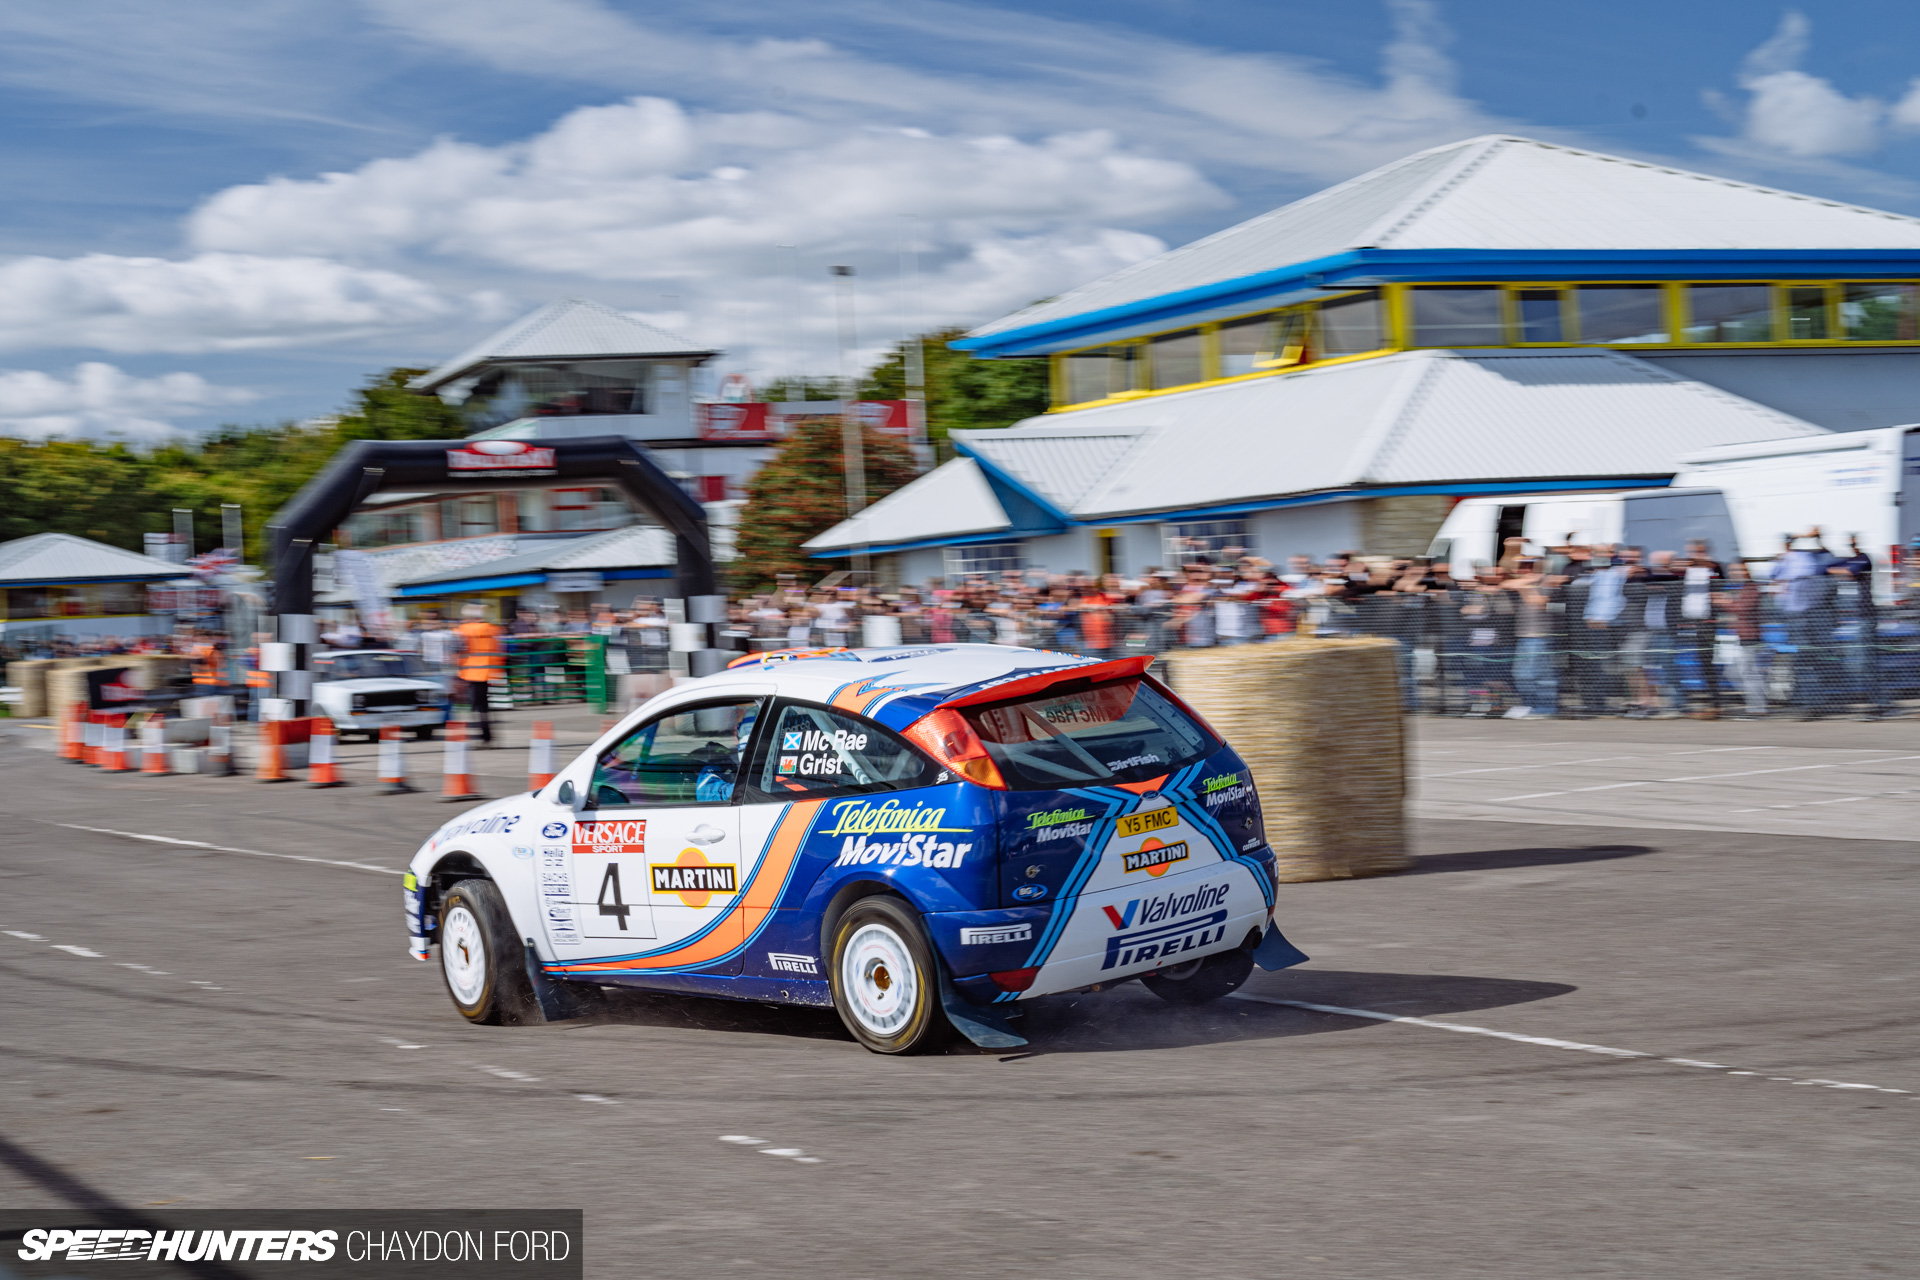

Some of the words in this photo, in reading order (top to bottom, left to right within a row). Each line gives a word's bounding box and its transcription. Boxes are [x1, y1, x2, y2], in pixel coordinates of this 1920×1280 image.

[802, 730, 829, 751] Mc
[832, 729, 867, 751] Rae
[800, 753, 843, 775] Grist
[1106, 754, 1160, 772] DirtFish
[1206, 785, 1246, 808] MoviStar
[574, 821, 645, 845] VERSACE
[1036, 822, 1093, 843] MoviStar
[1124, 818, 1141, 833] Y5
[1144, 811, 1172, 830] FMC
[592, 845, 624, 853] SPORT
[834, 833, 973, 869] MoviStar
[1127, 842, 1187, 870] MARTINI
[654, 868, 733, 890] MARTINI
[598, 862, 631, 931] 4
[1139, 883, 1230, 926] Valvoline
[960, 923, 1032, 945] PIRELLI
[1100, 908, 1228, 971] PIRELLI
[768, 952, 818, 974] PIRELLI
